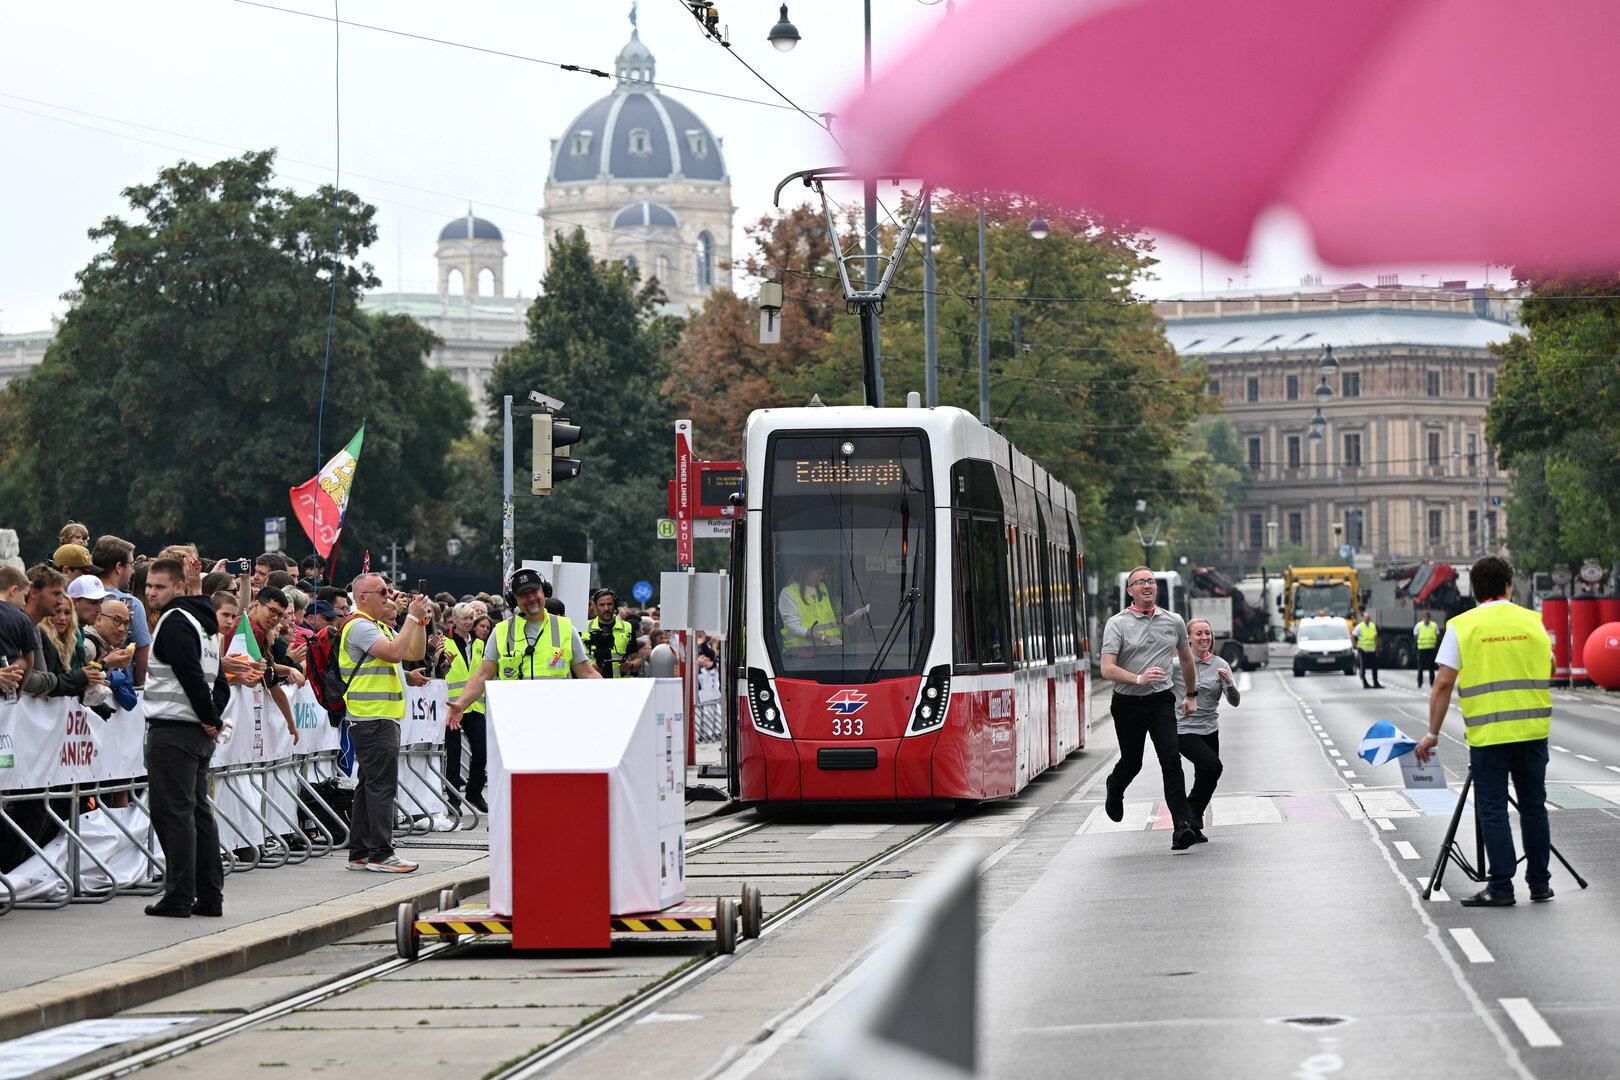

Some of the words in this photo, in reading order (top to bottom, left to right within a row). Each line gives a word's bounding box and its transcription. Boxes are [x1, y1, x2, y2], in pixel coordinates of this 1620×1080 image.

[796, 460, 901, 485] Edinburgh
[663, 524, 671, 534] H
[1481, 636, 1506, 644] WIENER
[832, 718, 864, 736] 333
